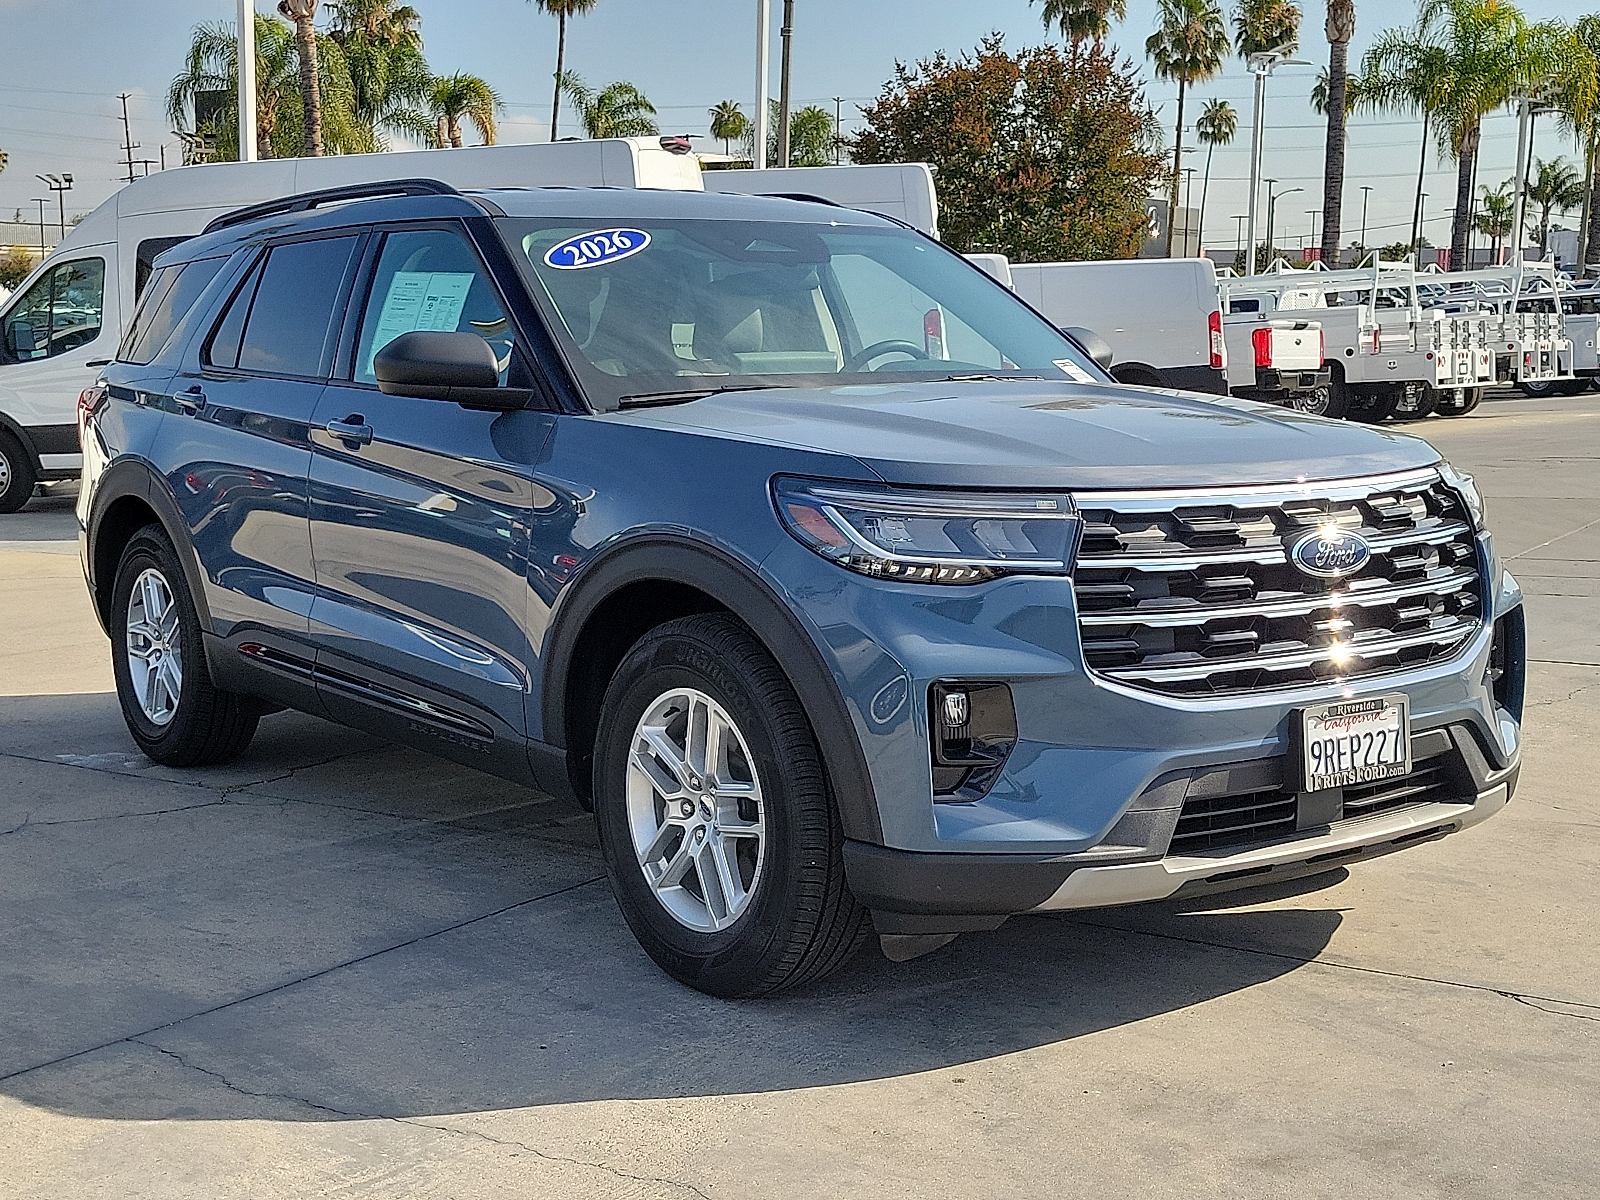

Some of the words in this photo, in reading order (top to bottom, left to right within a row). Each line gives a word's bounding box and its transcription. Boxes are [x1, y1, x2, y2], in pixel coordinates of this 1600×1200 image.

[563, 230, 632, 266] 2026
[1315, 538, 1356, 567] Ford
[1324, 711, 1388, 732] California
[1336, 701, 1376, 716] Riverside
[1310, 727, 1400, 775] 9REP227
